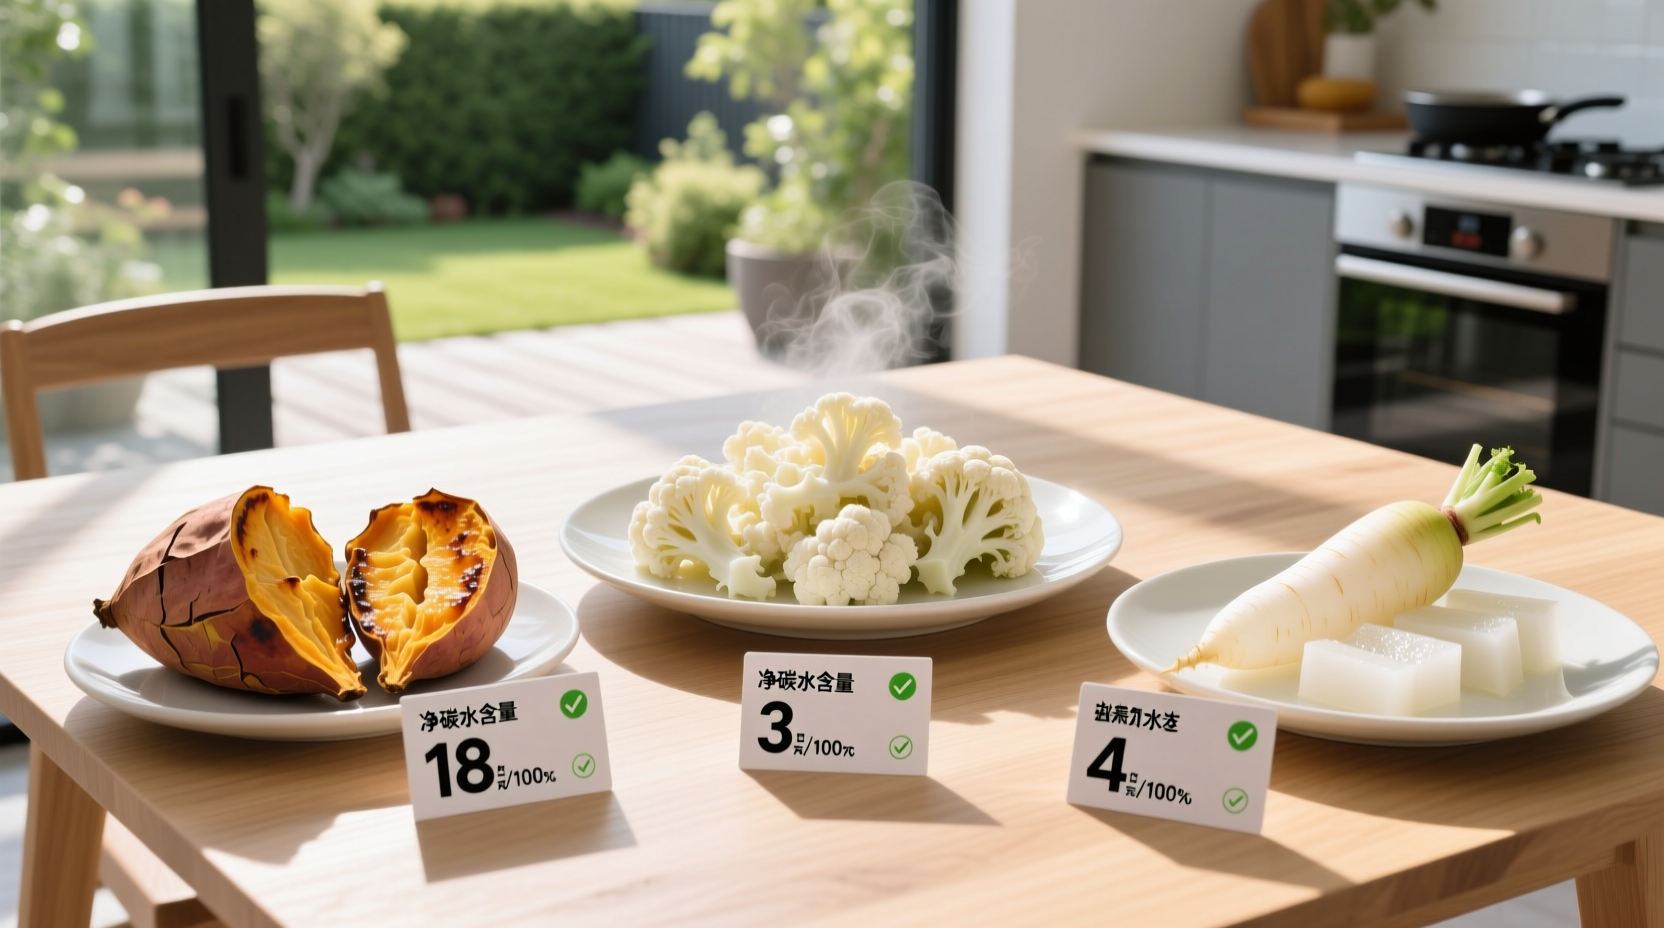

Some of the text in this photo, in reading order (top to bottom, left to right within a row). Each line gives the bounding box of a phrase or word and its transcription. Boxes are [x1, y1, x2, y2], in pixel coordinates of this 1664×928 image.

[419, 701, 518, 732] 净碳水含量
[757, 701, 793, 754] 3
[425, 737, 494, 798] 18
[1086, 736, 1127, 793] 4
